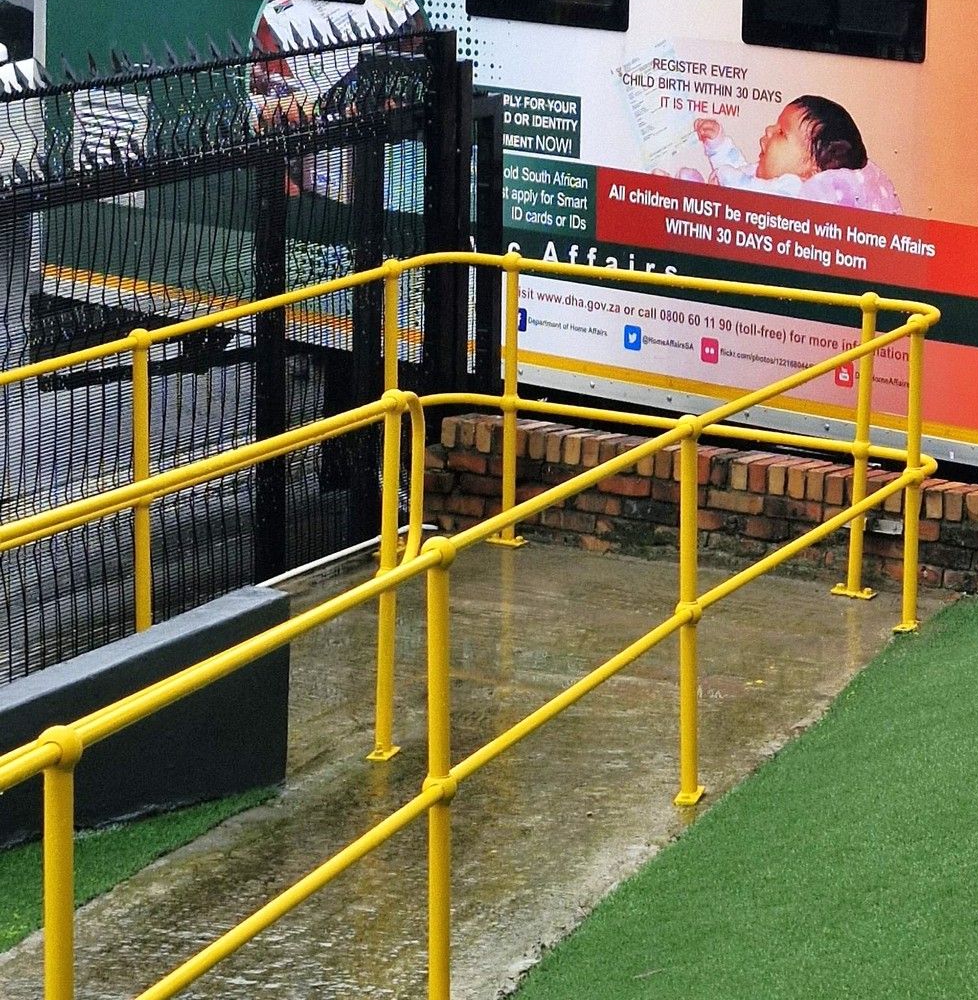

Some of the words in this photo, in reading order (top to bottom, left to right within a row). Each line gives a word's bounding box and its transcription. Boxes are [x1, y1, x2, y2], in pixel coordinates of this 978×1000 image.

[652, 57, 707, 76] REGISTER
[711, 64, 748, 81] EVERY
[622, 72, 655, 89] CHILD
[658, 77, 691, 93] BIRTH
[694, 82, 733, 98] WITHIN
[736, 86, 749, 100] 30
[752, 88, 783, 104] DAYS
[503, 94, 521, 109] PLY
[524, 96, 545, 111] FOR
[547, 99, 578, 115] YOUR
[660, 96, 671, 109] IT
[673, 97, 684, 111] IS
[687, 98, 709, 114] THE
[712, 102, 741, 118] LAW!
[514, 112, 530, 127] OR
[532, 114, 579, 133] IDENTITY
[535, 135, 573, 155] NOW!
[503, 165, 519, 180] old
[521, 167, 551, 185] South
[553, 171, 589, 190] African
[511, 188, 539, 207] apply
[541, 189, 555, 206] for
[557, 191, 588, 211] Smart
[511, 205, 523, 221] ID
[525, 210, 554, 226] cards
[555, 215, 567, 228] or
[569, 214, 587, 231] IDs
[608, 183, 626, 202] All
[629, 188, 679, 212] children
[682, 196, 722, 220] MUST
[725, 203, 742, 223] be
[745, 210, 811, 237] registered
[814, 219, 842, 242] with
[846, 225, 888, 250] Home
[890, 232, 937, 258] Affairs
[664, 217, 712, 242] WITHIN
[716, 225, 732, 246] 30
[735, 229, 774, 253] DAYS
[776, 238, 792, 256] of
[794, 241, 831, 267] being
[835, 246, 868, 271] born
[518, 285, 534, 300] isit
[536, 291, 621, 313] www.dha.gov.za
[624, 305, 635, 318] or
[638, 306, 657, 320] call
[660, 308, 685, 325] 0800
[688, 313, 701, 327] 60
[704, 315, 715, 329] 11
[719, 317, 732, 333] 90
[735, 318, 788, 344] (toll-free)
[789, 329, 806, 345] for
[809, 336, 839, 350] more
[841, 338, 910, 362] infation
[528, 316, 562, 330] Department
[563, 322, 570, 330] of
[570, 325, 587, 334] Home
[588, 327, 608, 337] Affairs
[642, 334, 694, 351] @HomeAffairsSA
